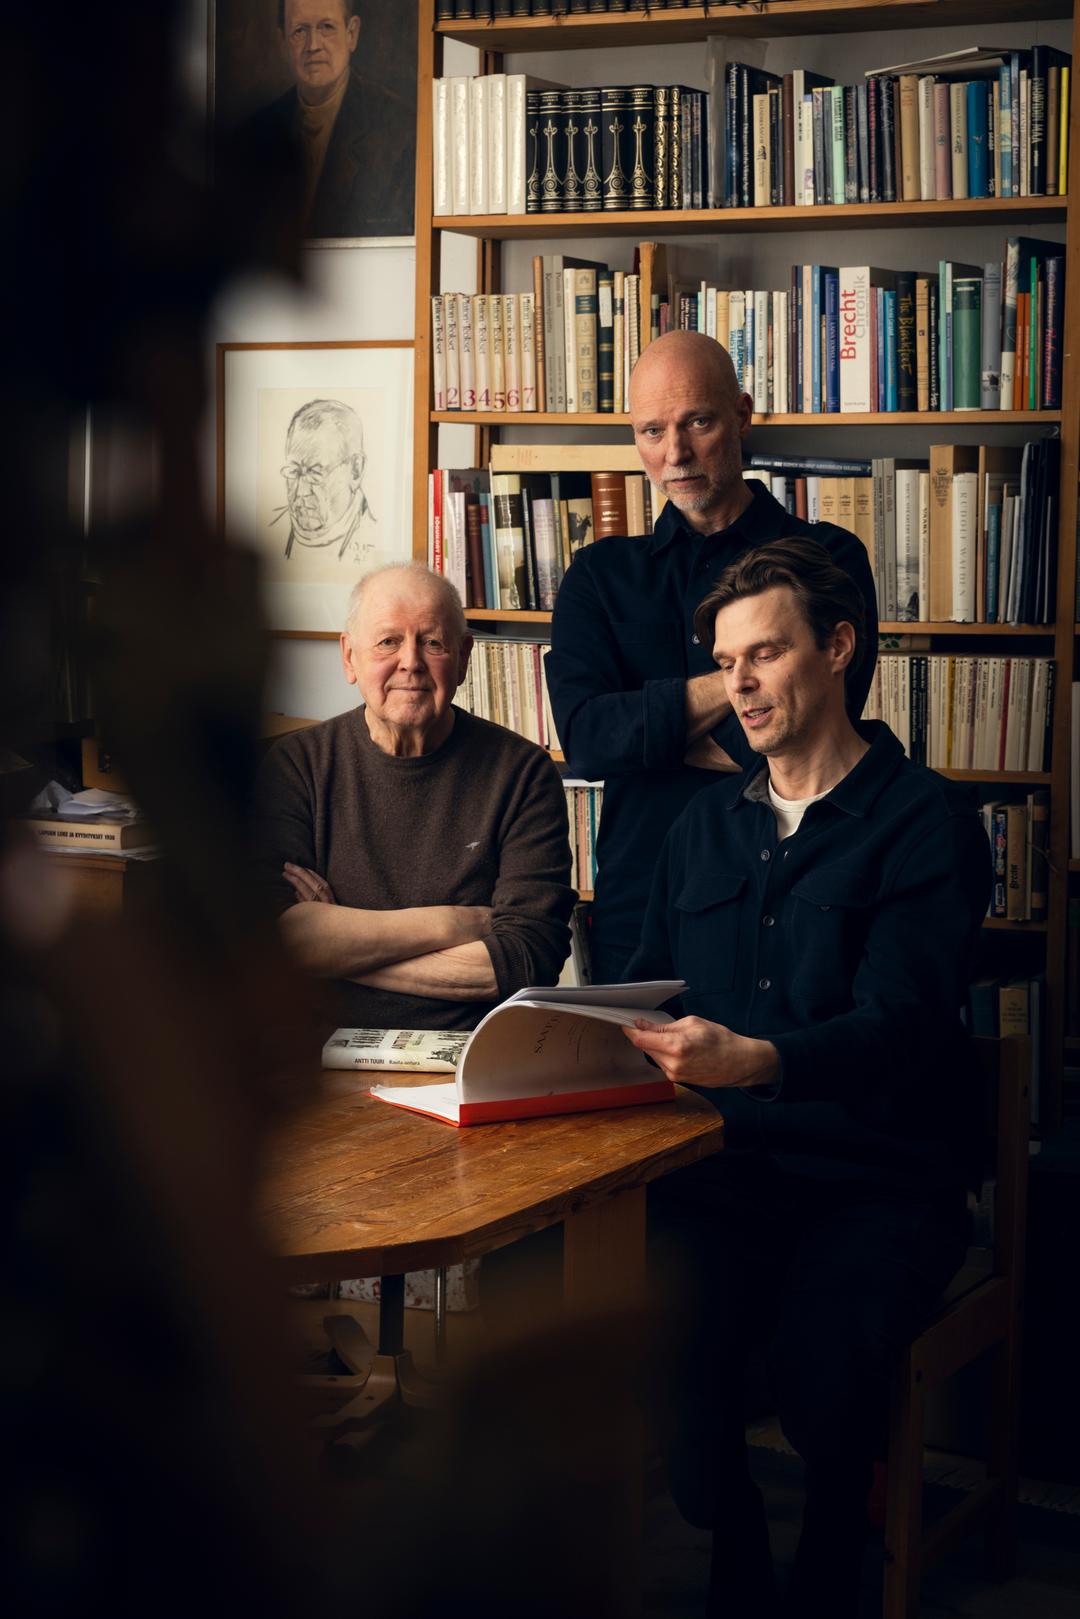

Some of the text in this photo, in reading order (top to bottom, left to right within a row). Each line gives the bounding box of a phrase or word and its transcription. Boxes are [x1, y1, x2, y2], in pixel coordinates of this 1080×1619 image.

[853, 274, 866, 339] Chronik
[840, 289, 857, 360] Brecht
[898, 317, 914, 376] Blackfeet
[438, 391, 443, 409] 1
[447, 387, 458, 405] 2
[463, 389, 476, 407] 3
[478, 388, 490, 406] 4
[494, 391, 505, 409] 5
[507, 390, 519, 407] 6
[524, 387, 534, 404] 7
[959, 492, 968, 597] RUDOLF WALDEN
